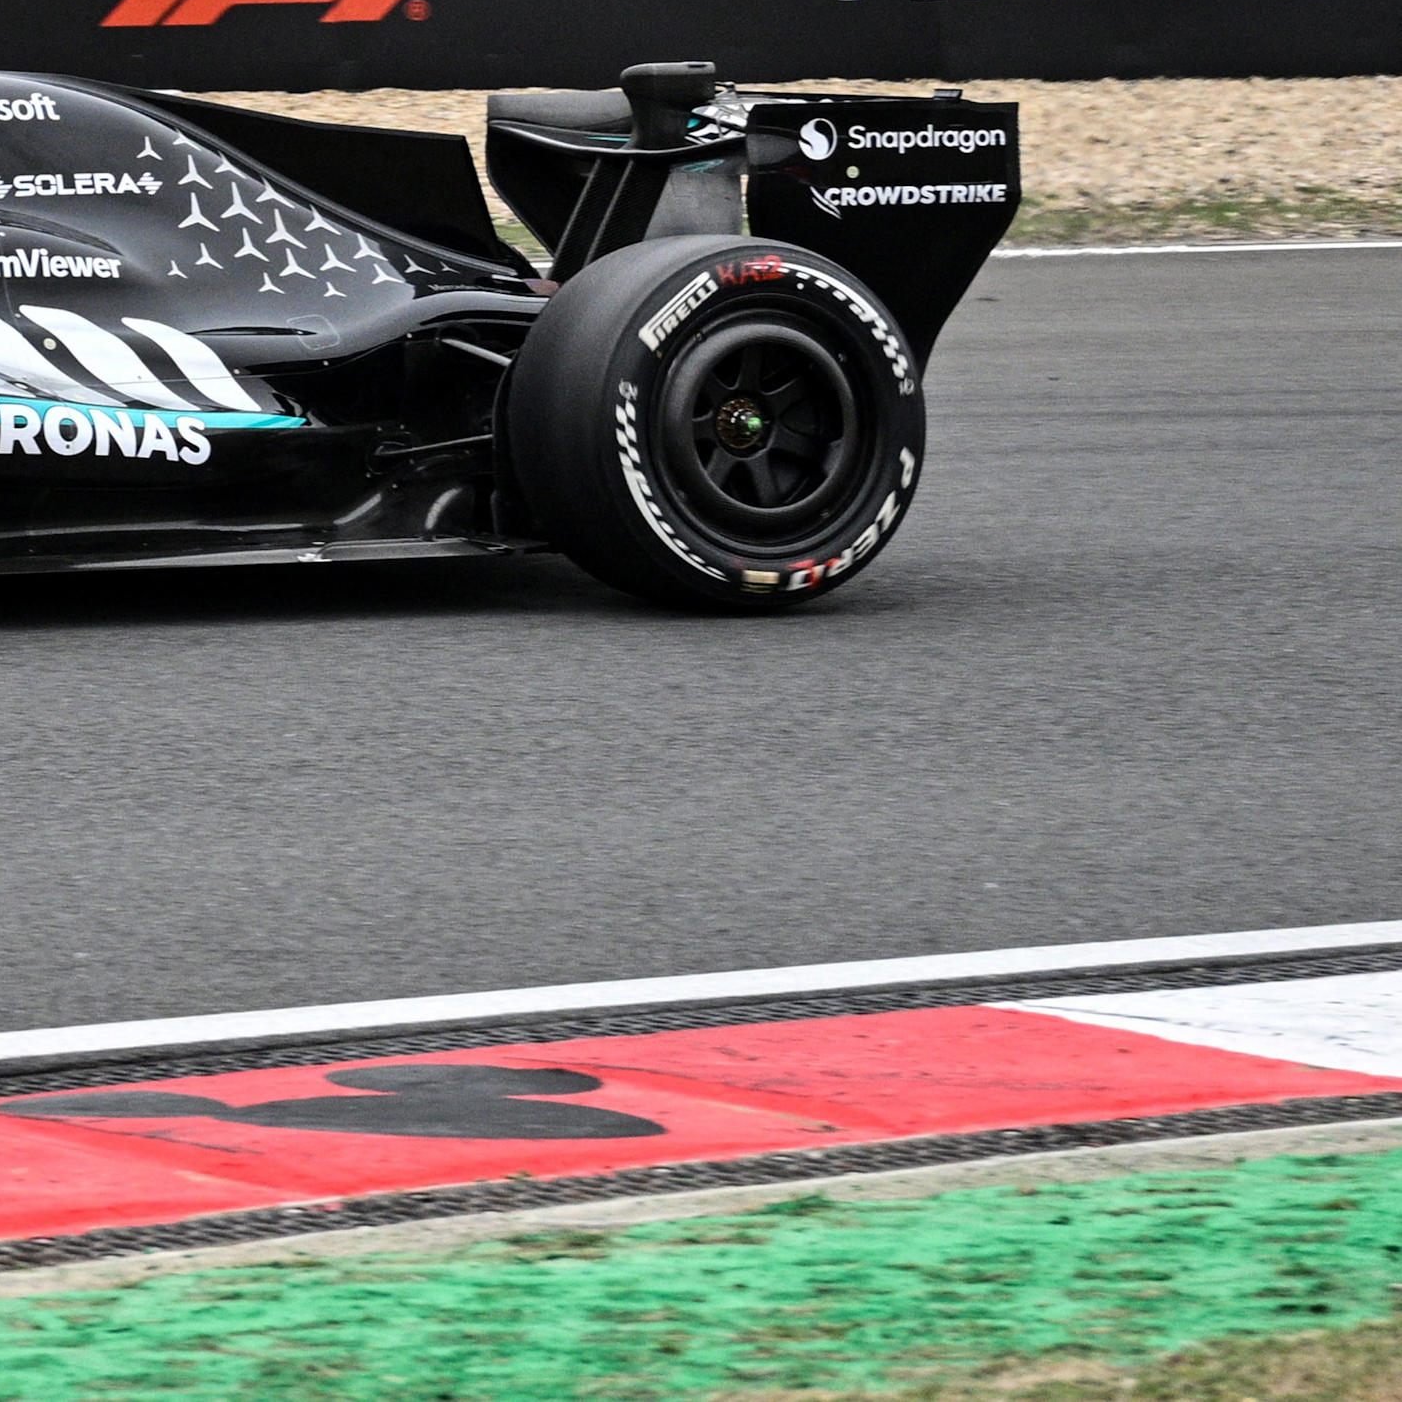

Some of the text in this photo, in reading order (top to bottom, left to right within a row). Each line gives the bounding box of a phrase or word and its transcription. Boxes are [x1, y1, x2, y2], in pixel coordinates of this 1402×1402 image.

[847, 124, 1007, 154] Snapdragon
[13, 172, 138, 198] SOLERA
[824, 183, 1007, 208] CROWDSTRIKE
[638, 271, 719, 352] PIRELLI
[786, 446, 916, 592] P ZERO
